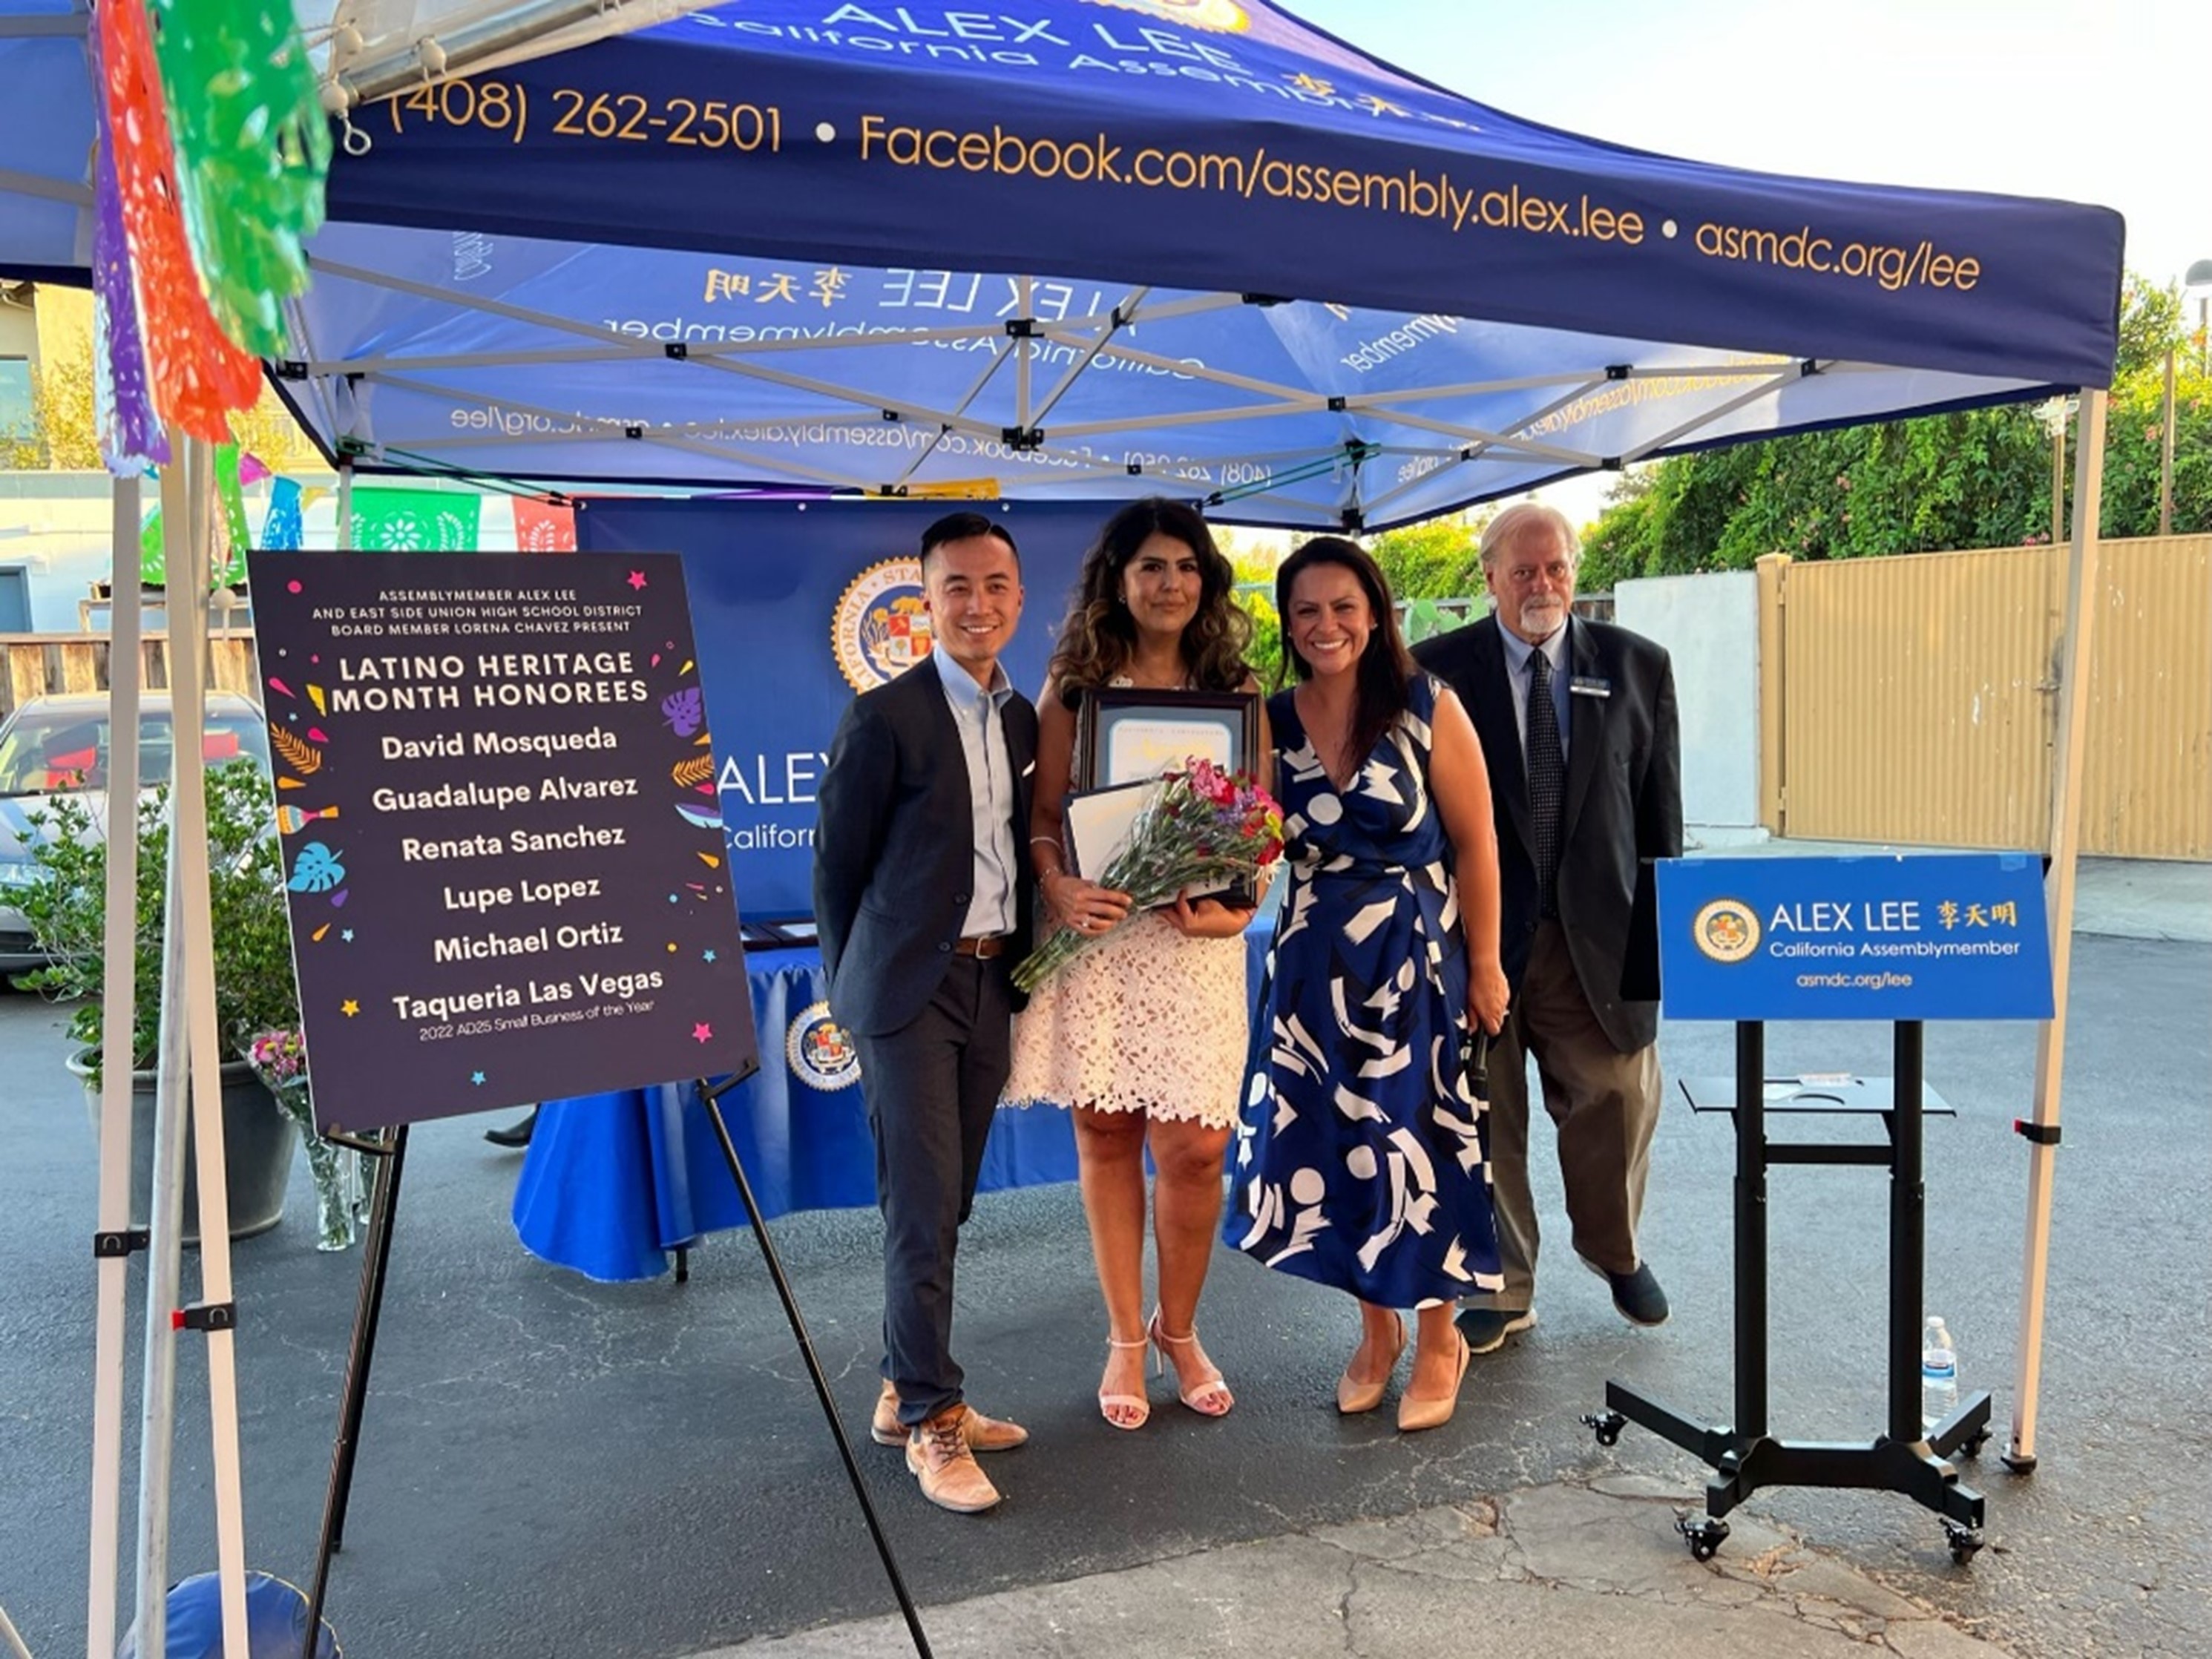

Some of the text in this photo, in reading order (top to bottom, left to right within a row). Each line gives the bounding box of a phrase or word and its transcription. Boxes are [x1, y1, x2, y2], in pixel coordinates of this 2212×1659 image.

[821, 2, 1070, 45] ALEX
[1092, 22, 1256, 76] LEE
[390, 78, 1980, 291] (408) 262-2501 Facebook.com/assembly.alex.lee asmdc.org/lee
[312, 605, 642, 620] AND EAST SIDE UNION HIGH SCHOOL DISTRICT
[379, 590, 577, 602] ASSEMBLYMEMBER ALEX LEE
[331, 620, 630, 637] BOARD MEMBER LORENA CHAVEZ PRESENT
[340, 652, 634, 681] LATINO HERITAGE
[332, 680, 649, 712] MONTH HONOREES
[381, 725, 618, 760] David Mosqueda
[372, 775, 639, 812] Guadalupe Alvarez
[716, 751, 830, 805] ALE
[401, 824, 626, 862] Renata Sanchez
[444, 878, 602, 914] Lupe Lopez
[1769, 903, 1854, 933] ALEX
[1864, 901, 1921, 932] LEE
[1937, 900, 2018, 930] 李天明
[434, 921, 624, 963] Michael Ortiz
[1770, 940, 2021, 959] California Assemblymember
[392, 970, 664, 1022] Taqueria Las Vegas
[1796, 971, 1913, 991] asmdc.org/lee
[419, 1024, 454, 1042] 2022
[494, 1014, 528, 1032] Small
[530, 1008, 585, 1027] Business
[585, 1004, 601, 1020] of
[603, 1003, 624, 1016] the
[626, 999, 655, 1014] Year
